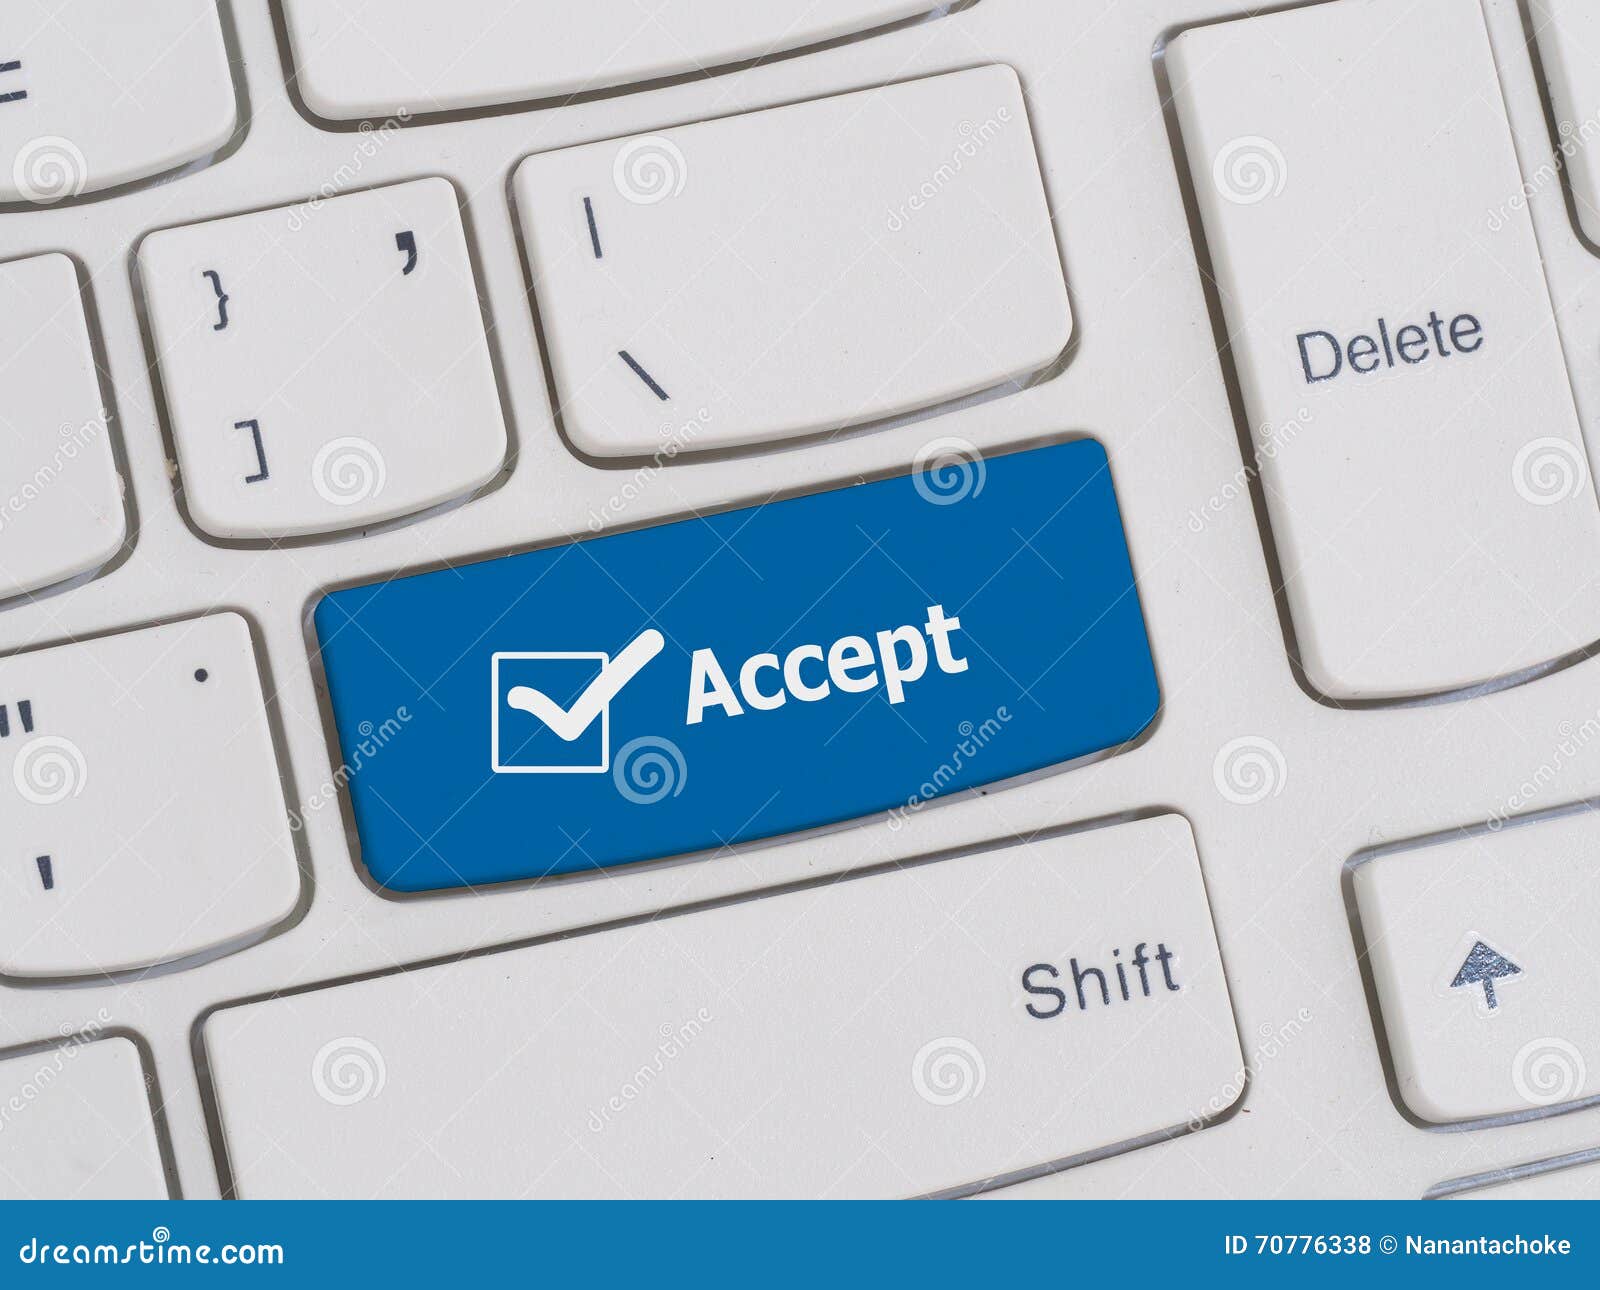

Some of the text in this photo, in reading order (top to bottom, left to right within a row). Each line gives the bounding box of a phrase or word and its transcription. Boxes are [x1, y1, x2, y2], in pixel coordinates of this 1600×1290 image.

[202, 270, 229, 331] }
[617, 350, 670, 401] \
[1295, 310, 1484, 386] Delete
[234, 419, 269, 484] ]
[686, 604, 969, 725] Accept
[1021, 941, 1181, 1020] Shift
